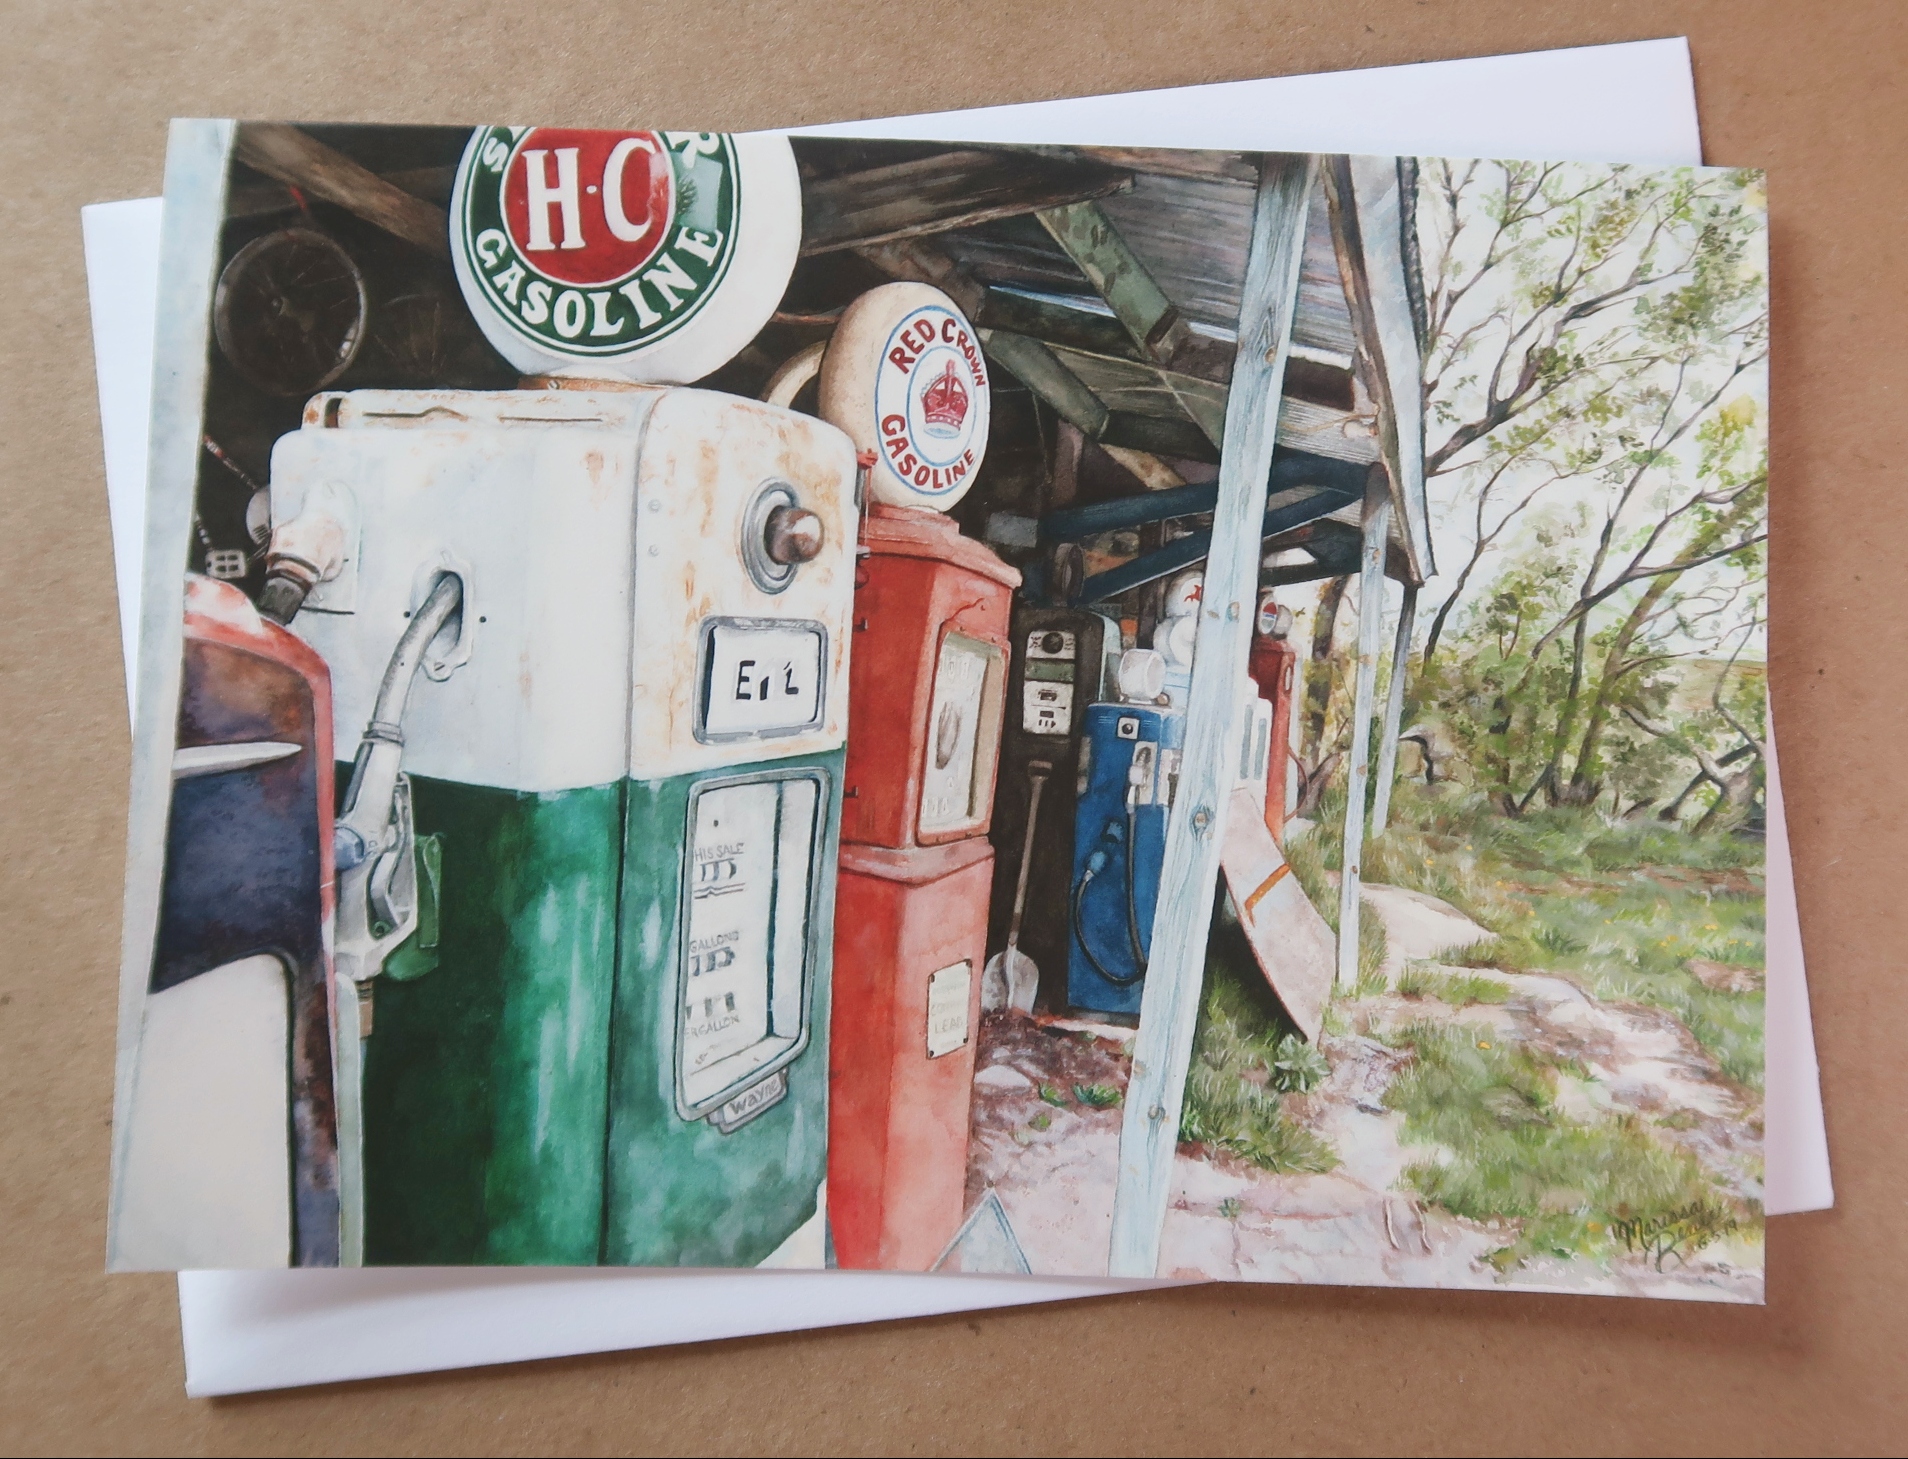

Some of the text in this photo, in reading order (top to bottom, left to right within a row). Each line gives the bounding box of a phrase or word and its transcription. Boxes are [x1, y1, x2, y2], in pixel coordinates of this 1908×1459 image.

[475, 226, 724, 339] GASOLINE
[888, 317, 986, 387] RED CROWN
[881, 414, 975, 489] GASOLINE
[715, 841, 745, 859] SALE
